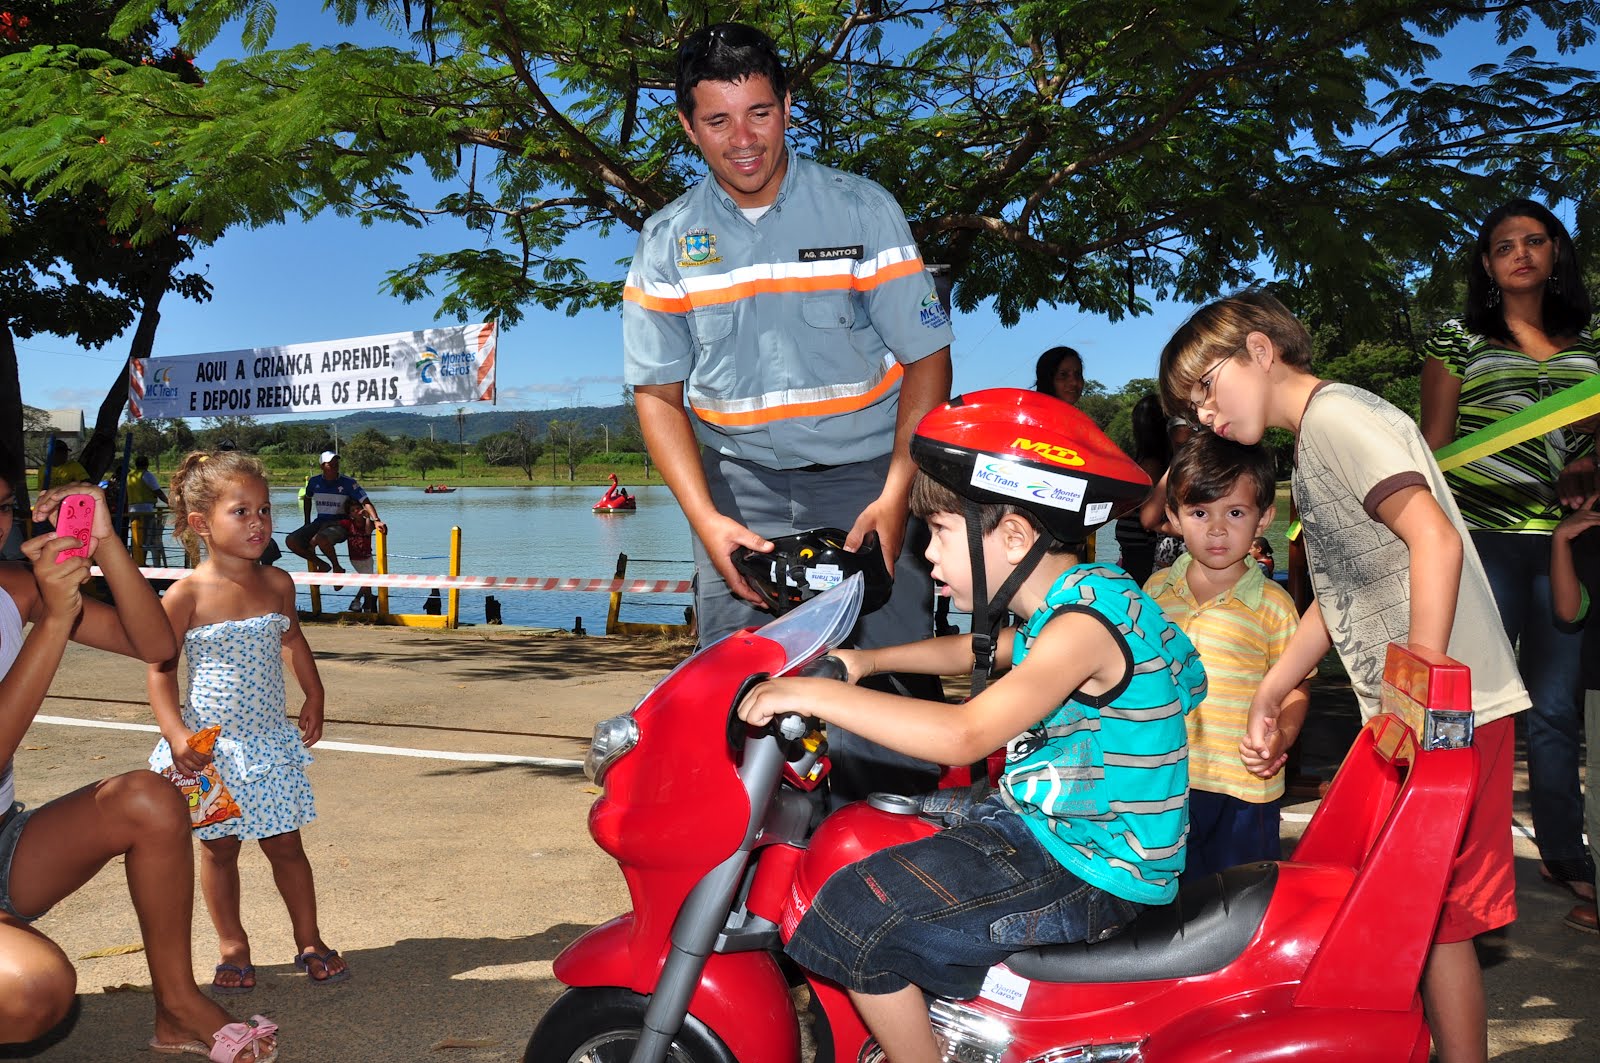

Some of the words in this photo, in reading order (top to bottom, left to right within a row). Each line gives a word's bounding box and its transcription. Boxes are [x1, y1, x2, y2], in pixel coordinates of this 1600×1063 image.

[820, 248, 858, 258] SANTOS
[196, 360, 227, 383] AQUI
[235, 359, 246, 380] A
[254, 353, 313, 379] CRIANÇA
[320, 344, 396, 373] APRENDE,
[441, 350, 477, 365] Montes
[440, 364, 471, 377] Claros
[159, 384, 178, 397] Trans
[190, 391, 197, 411] E
[203, 388, 251, 411] DEPOIS
[257, 382, 322, 408] REEDUCA
[331, 380, 351, 404] OS
[356, 375, 403, 403] PAIS.
[976, 469, 991, 481] MC
[994, 474, 1019, 489] Trans
[1050, 493, 1074, 503] Claros
[1053, 487, 1081, 499] Montes
[990, 988, 1016, 1001] Claros
[994, 983, 1023, 998] Montes
